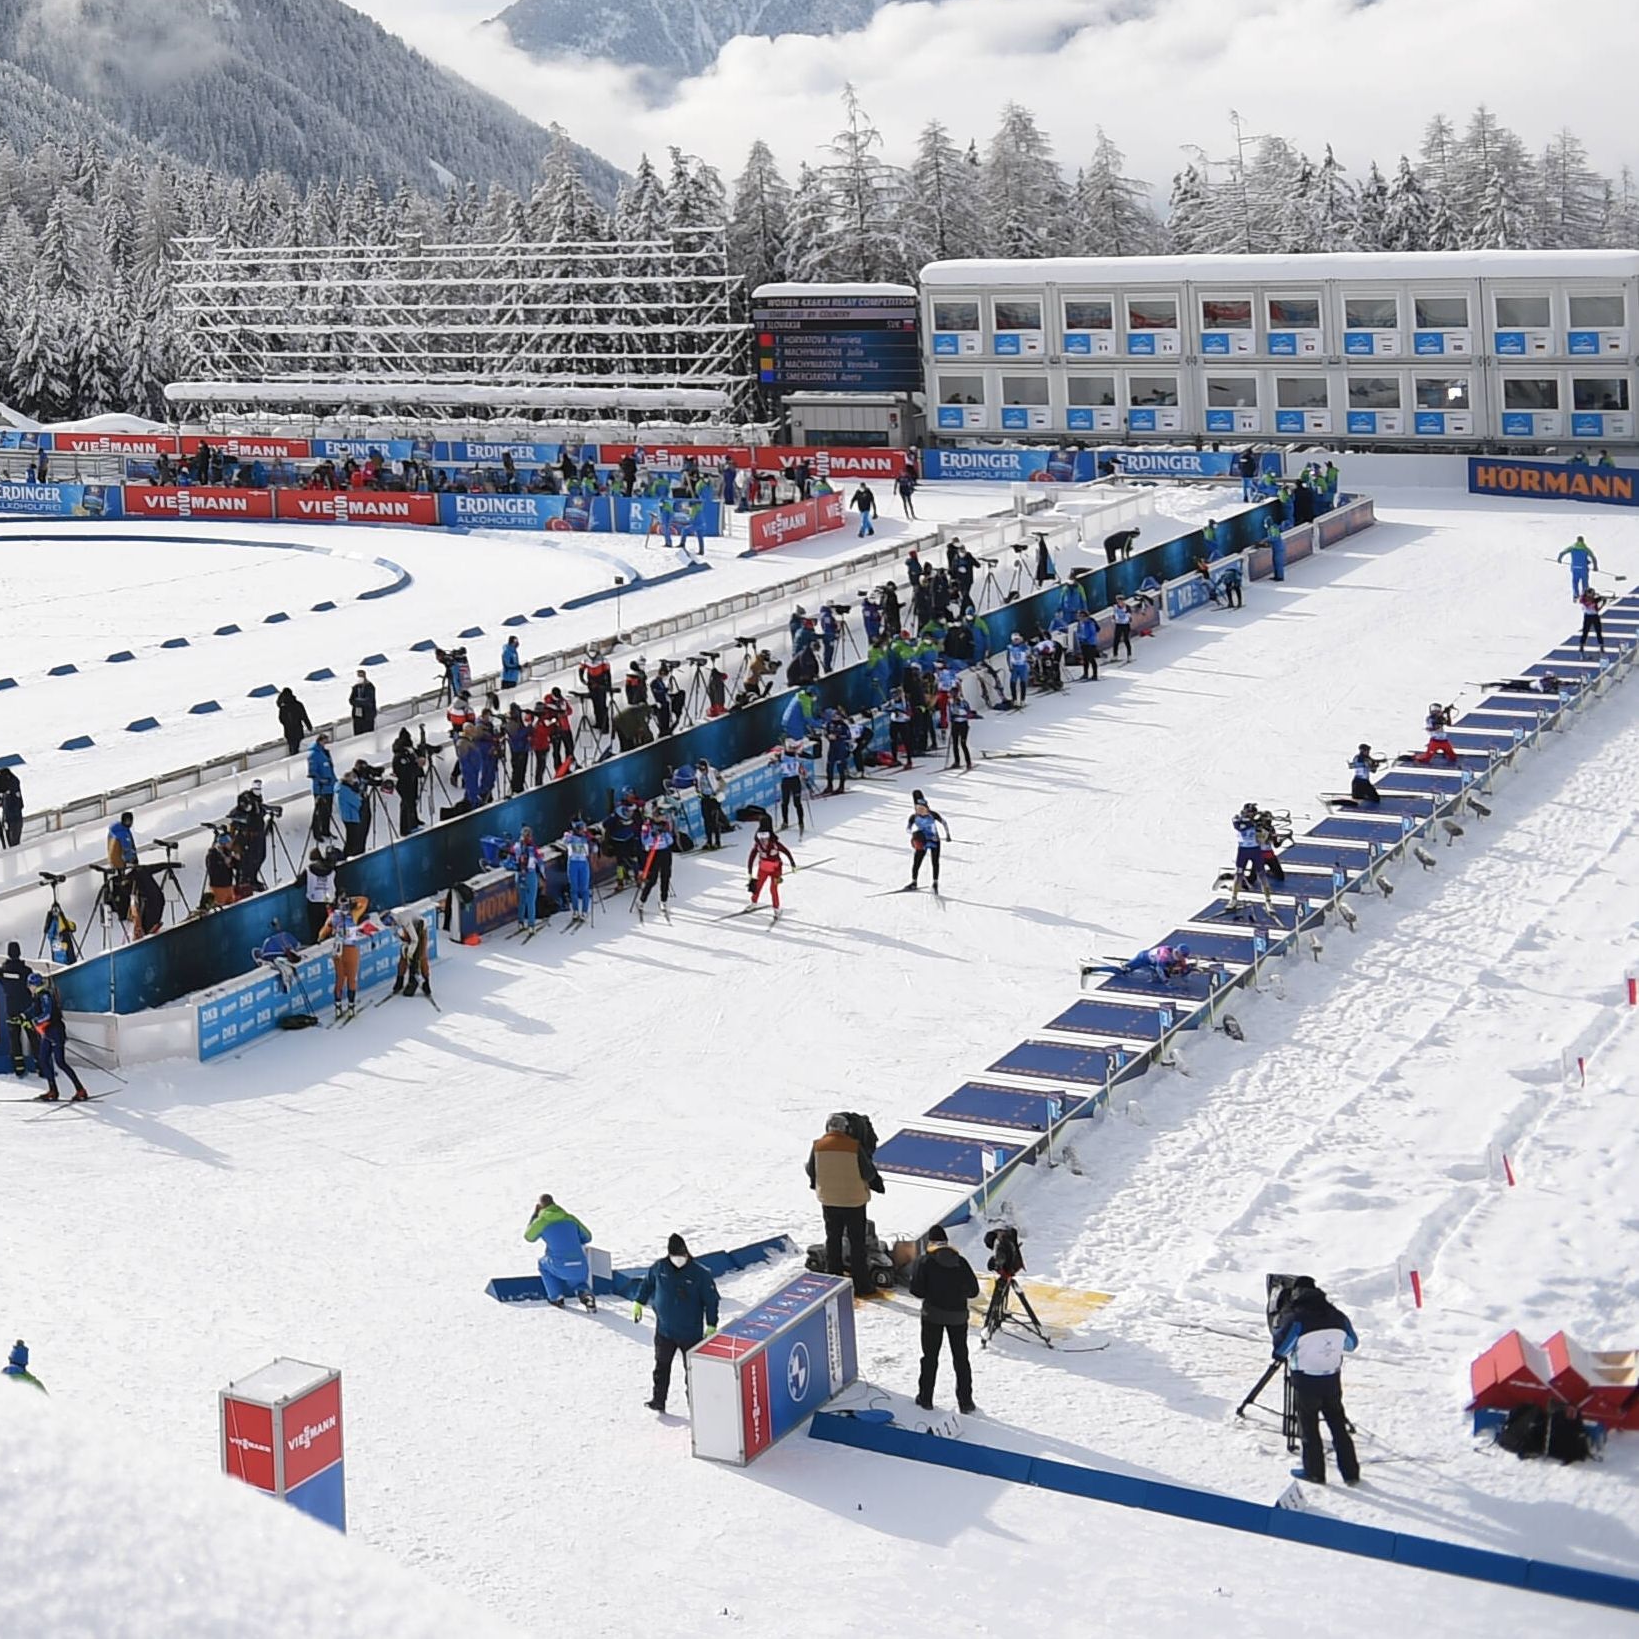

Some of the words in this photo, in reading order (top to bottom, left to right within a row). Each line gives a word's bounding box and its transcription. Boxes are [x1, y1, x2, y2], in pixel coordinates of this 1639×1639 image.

[940, 451, 1021, 470] ERDINGER
[1477, 466, 1632, 499] HÖRMANN
[144, 490, 247, 517] VIESSMANN
[298, 495, 409, 522] VIESSMANN
[456, 495, 537, 516] ERDINGER
[229, 1436, 271, 1453] VIESSMANN
[288, 1414, 336, 1451] VIESSMANN
